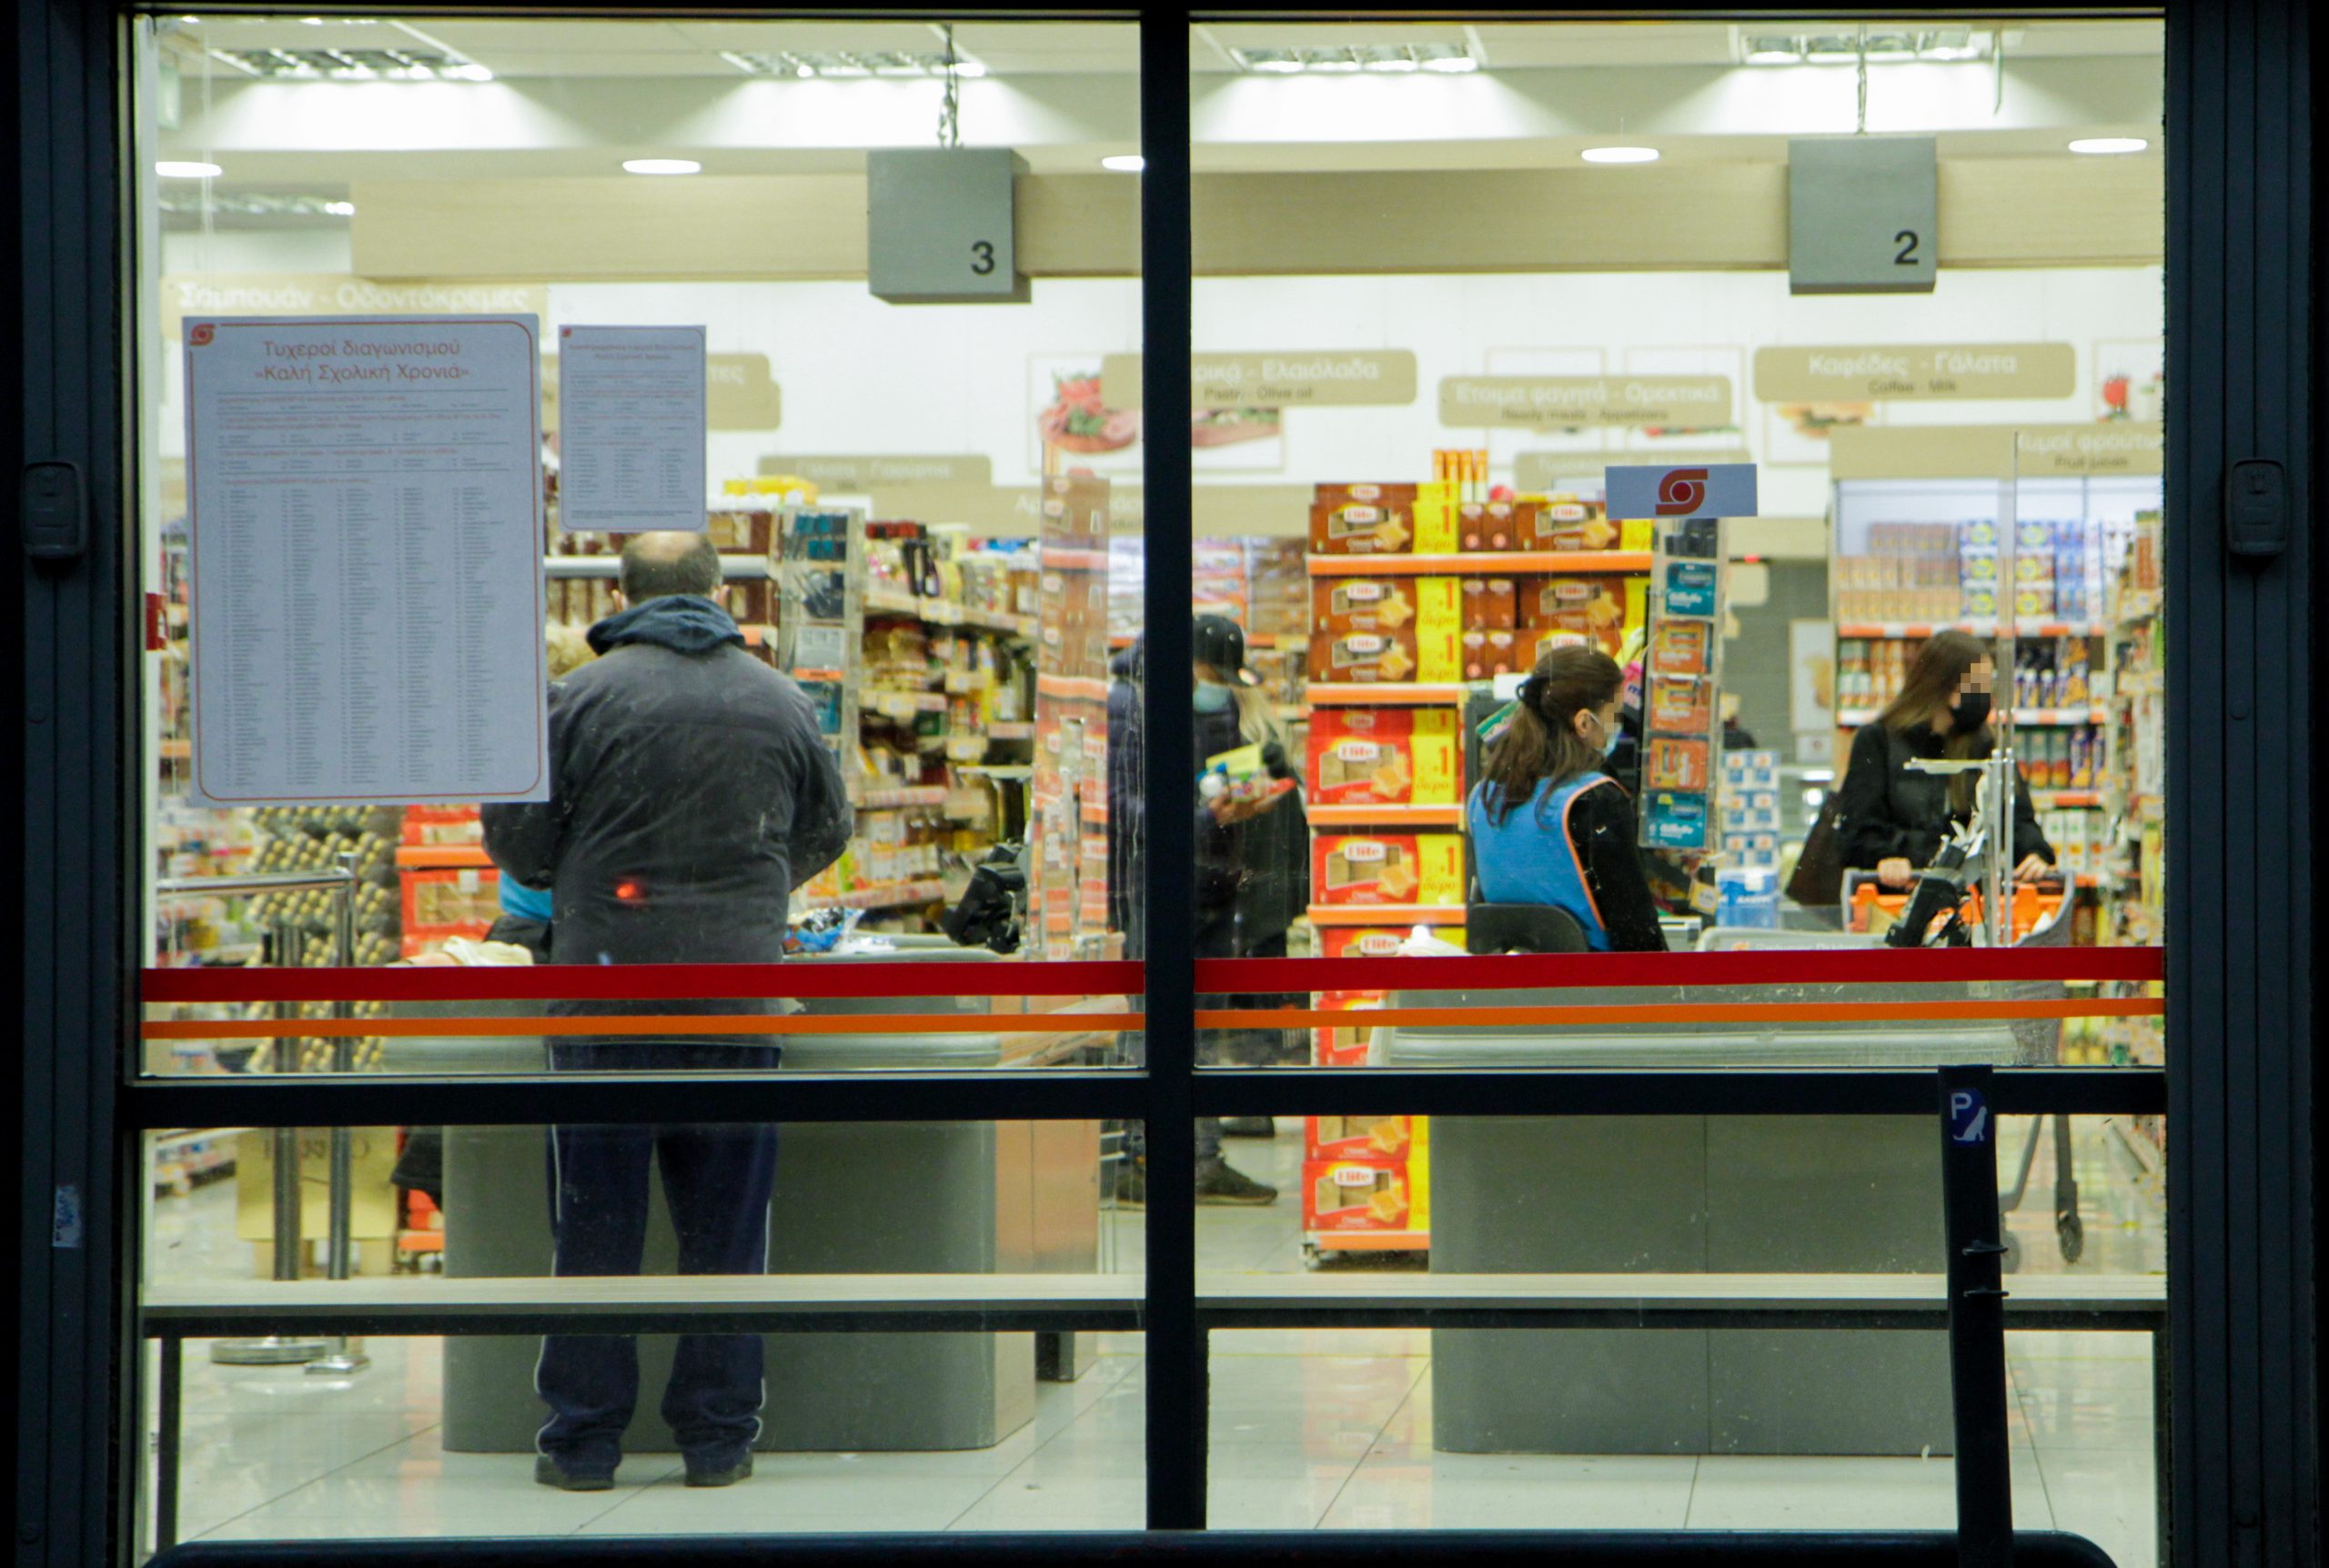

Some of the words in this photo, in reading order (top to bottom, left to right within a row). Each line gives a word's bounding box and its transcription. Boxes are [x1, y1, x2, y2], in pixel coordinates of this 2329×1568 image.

[971, 239, 994, 276] 3
[1894, 229, 1919, 265] 2
[179, 283, 315, 312] Σαμπουάν
[335, 283, 530, 313] Οδοντόκρεμες
[262, 339, 337, 360] Τυχεροί
[343, 338, 459, 360] διαγωνισμού
[255, 366, 311, 383] «Καλή
[319, 364, 390, 384] Σχολική
[397, 363, 469, 384] Χρονιά»
[1261, 356, 1379, 381] Ελαιόλαδα
[1809, 353, 1909, 378] Καφέδες
[1935, 352, 2018, 376] Γάλατα
[1340, 745, 1375, 759] Elite
[1346, 846, 1380, 859] Elite
[1362, 938, 1396, 950] Elite
[1951, 1092, 1972, 1121] P
[1337, 1171, 1371, 1183] Elite
